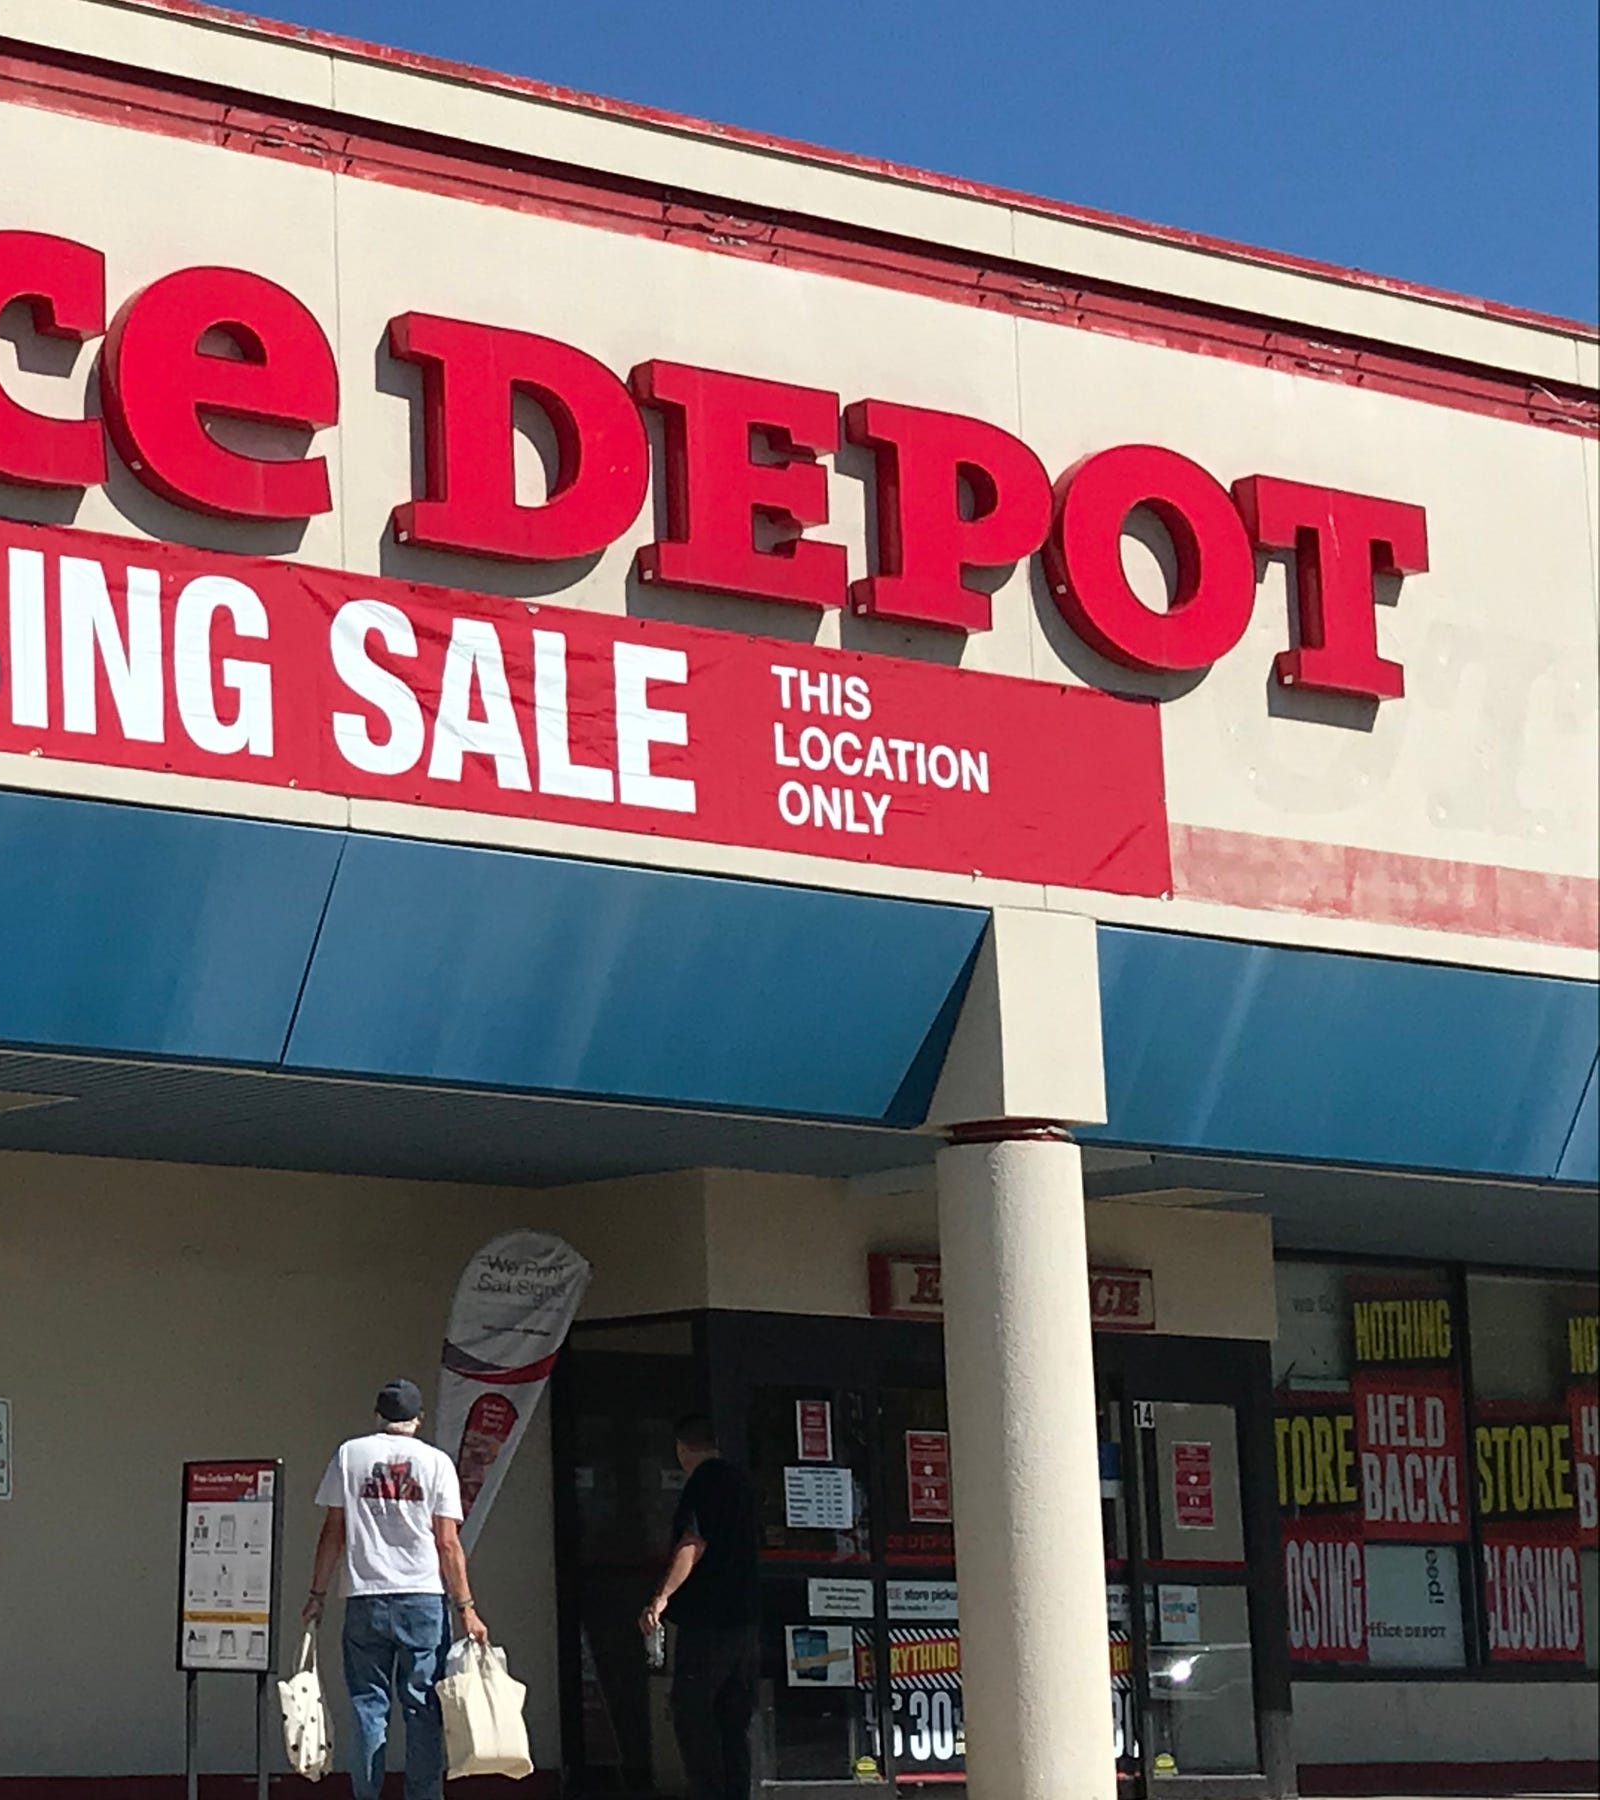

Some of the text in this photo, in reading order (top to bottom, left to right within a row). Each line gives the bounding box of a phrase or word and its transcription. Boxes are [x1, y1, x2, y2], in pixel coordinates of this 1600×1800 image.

[390, 312, 1429, 699] DEPOT
[330, 599, 696, 813] SALE
[771, 664, 872, 721] THIS
[774, 723, 990, 794] LOCATION
[778, 780, 892, 836] ONLY
[1353, 1299, 1451, 1362] NOTHING
[1135, 1403, 1154, 1427] 14
[1366, 1394, 1446, 1448] HELD
[1274, 1414, 1359, 1507] TORE
[1361, 1452, 1460, 1525] BACK!
[1474, 1424, 1574, 1514] STORE
[931, 1588, 958, 1603] picku
[1286, 1540, 1364, 1650] OSING
[1368, 1621, 1447, 1639] ffice DEPOT
